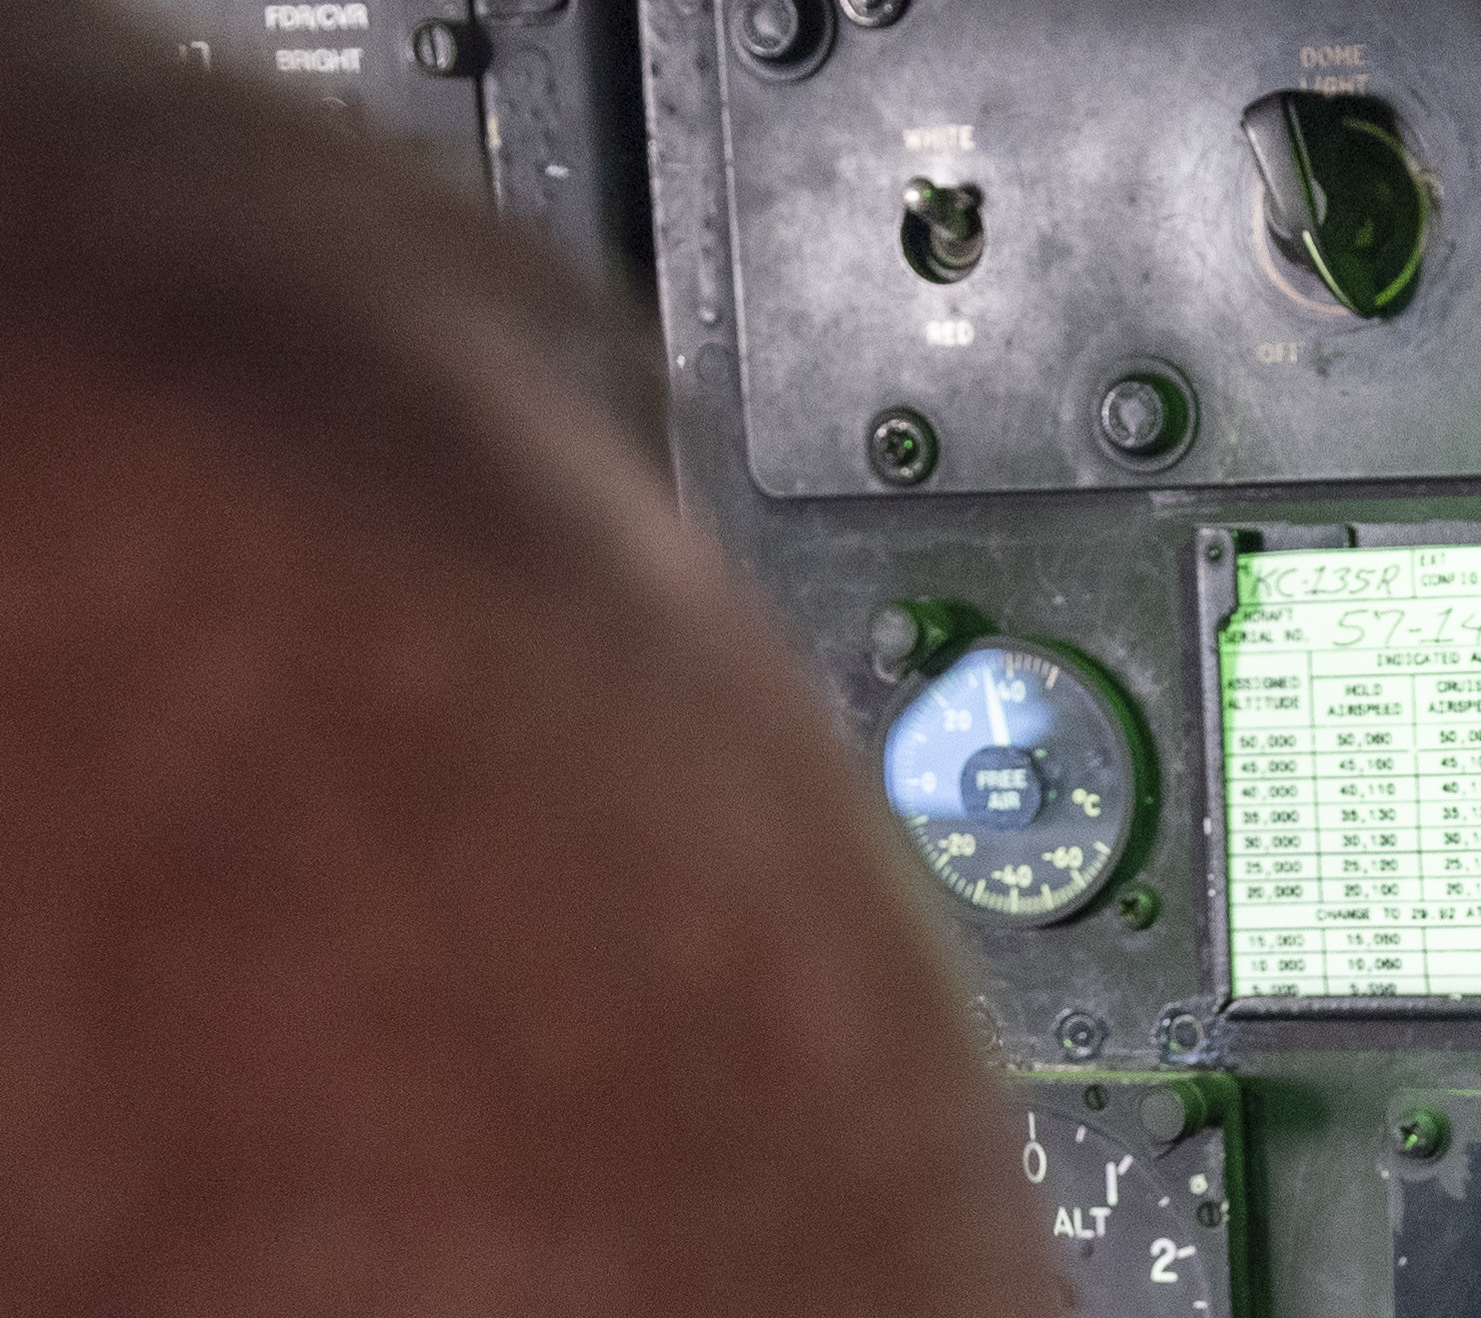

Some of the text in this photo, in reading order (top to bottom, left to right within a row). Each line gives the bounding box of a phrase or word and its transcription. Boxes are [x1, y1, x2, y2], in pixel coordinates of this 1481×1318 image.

[1258, 343, 1304, 363] OFF
[1249, 564, 1400, 598] KC-135R
[1377, 650, 1460, 668] INDICATED
[1327, 701, 1403, 718] AIRSPEED
[1023, 1141, 1047, 1184] 0
[1105, 1162, 1119, 1206] 1
[1054, 1207, 1111, 1239] ALT
[1150, 1237, 1180, 1284] 2
